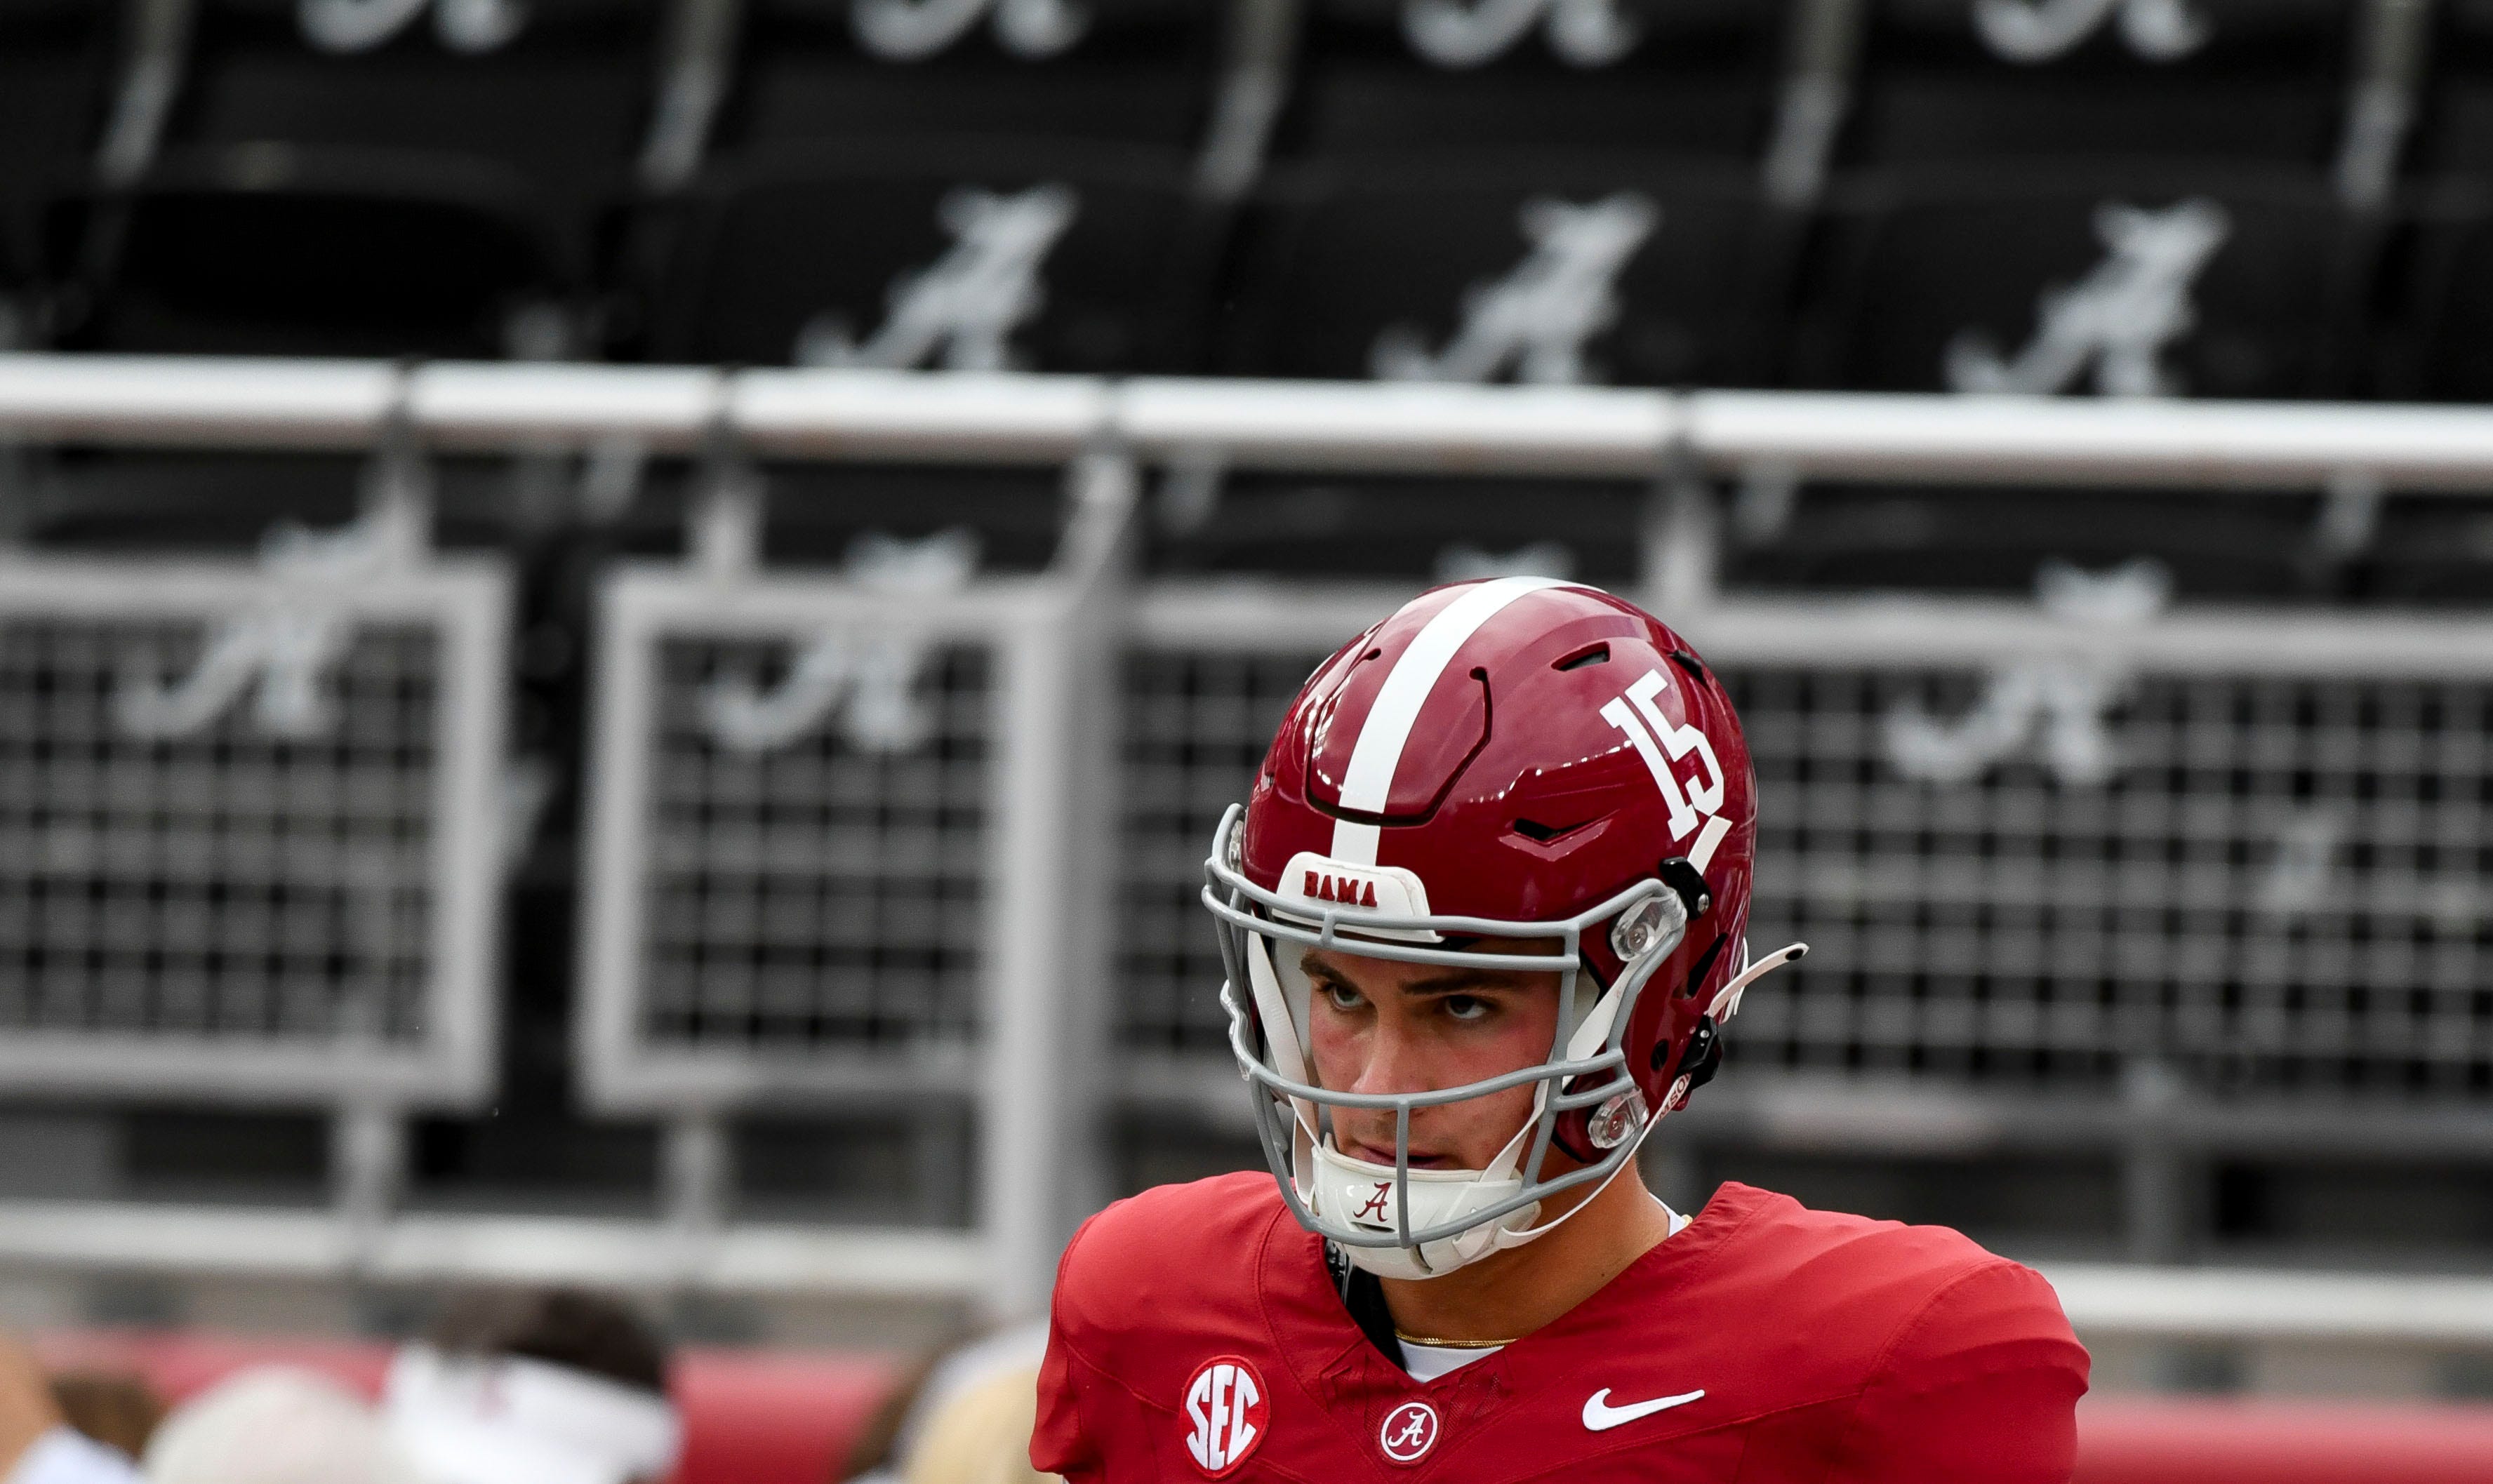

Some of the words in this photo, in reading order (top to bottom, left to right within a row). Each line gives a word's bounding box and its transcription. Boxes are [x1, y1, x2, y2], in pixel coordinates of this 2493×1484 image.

[1599, 669, 1724, 843] 15
[1303, 870, 1378, 907] BAMA
[1353, 1182, 1392, 1222] A
[1186, 1364, 1260, 1471] SEC
[1388, 1411, 1428, 1446] A
